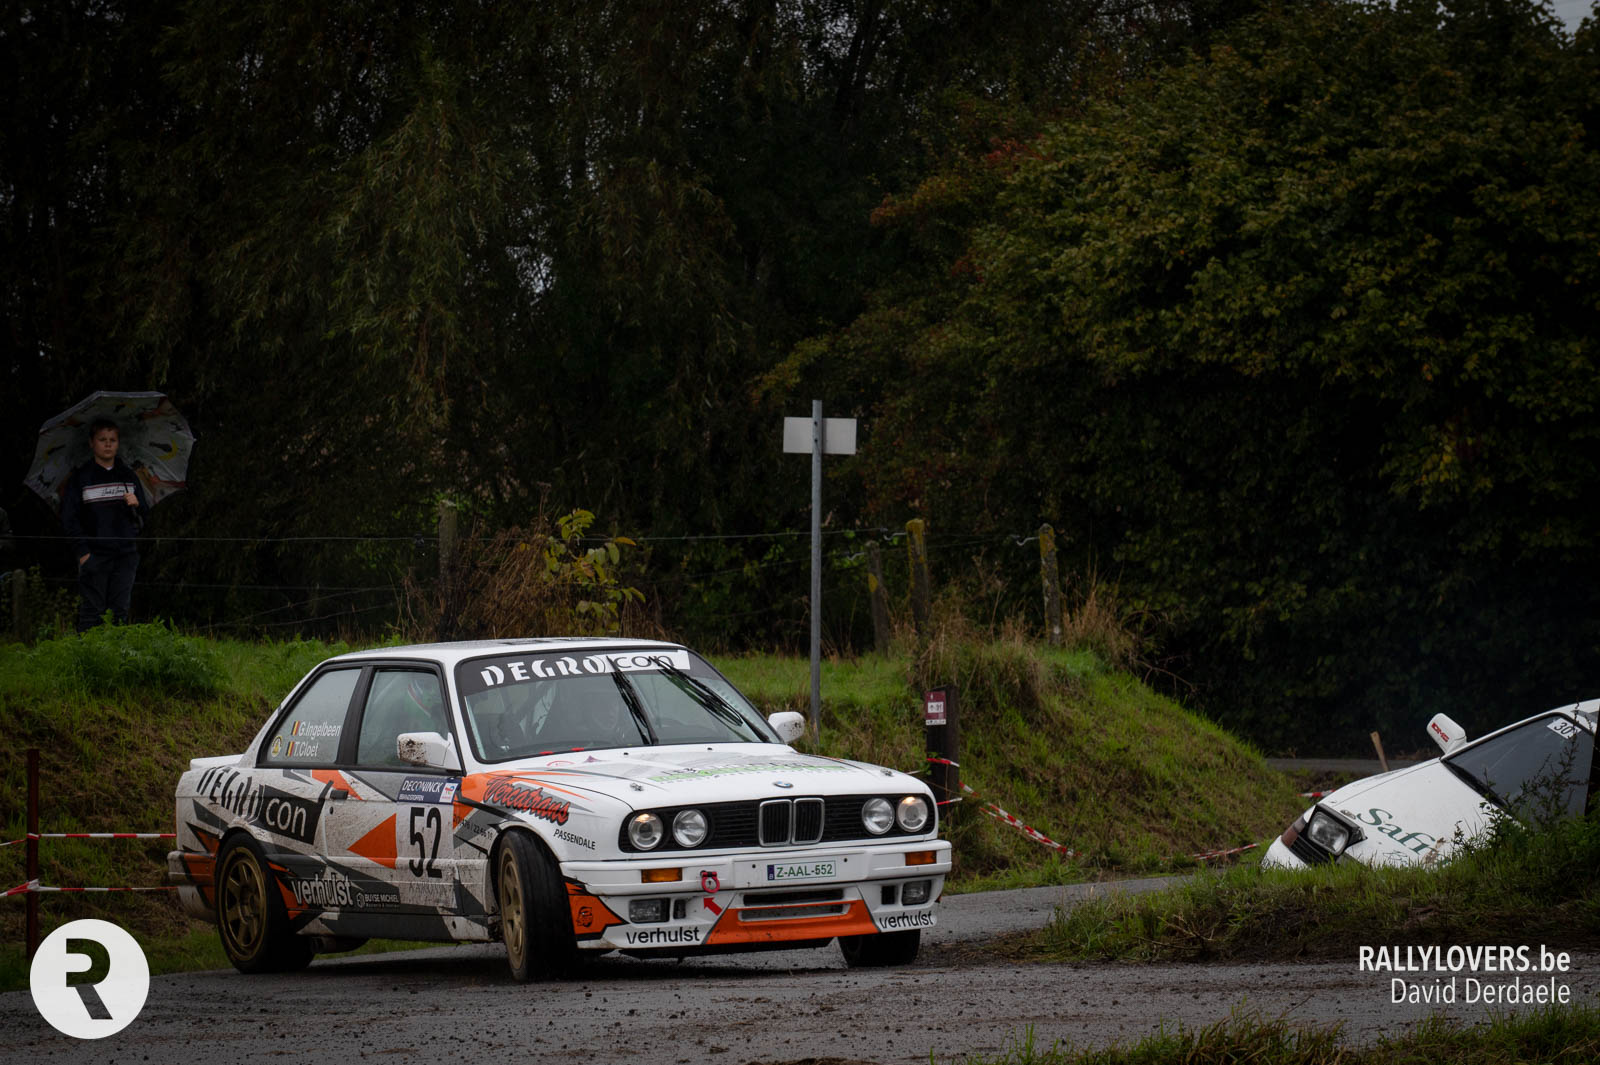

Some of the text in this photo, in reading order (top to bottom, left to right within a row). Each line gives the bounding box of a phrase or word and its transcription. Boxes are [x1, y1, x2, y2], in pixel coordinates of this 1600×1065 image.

[402, 780, 444, 793] DECONINCK
[409, 807, 442, 878] 52
[553, 828, 596, 850] PASSENDALE
[776, 864, 833, 877] Z-AAL-552
[291, 872, 354, 907] verhulst
[878, 910, 934, 930] verhulst
[625, 926, 700, 945] verhulst
